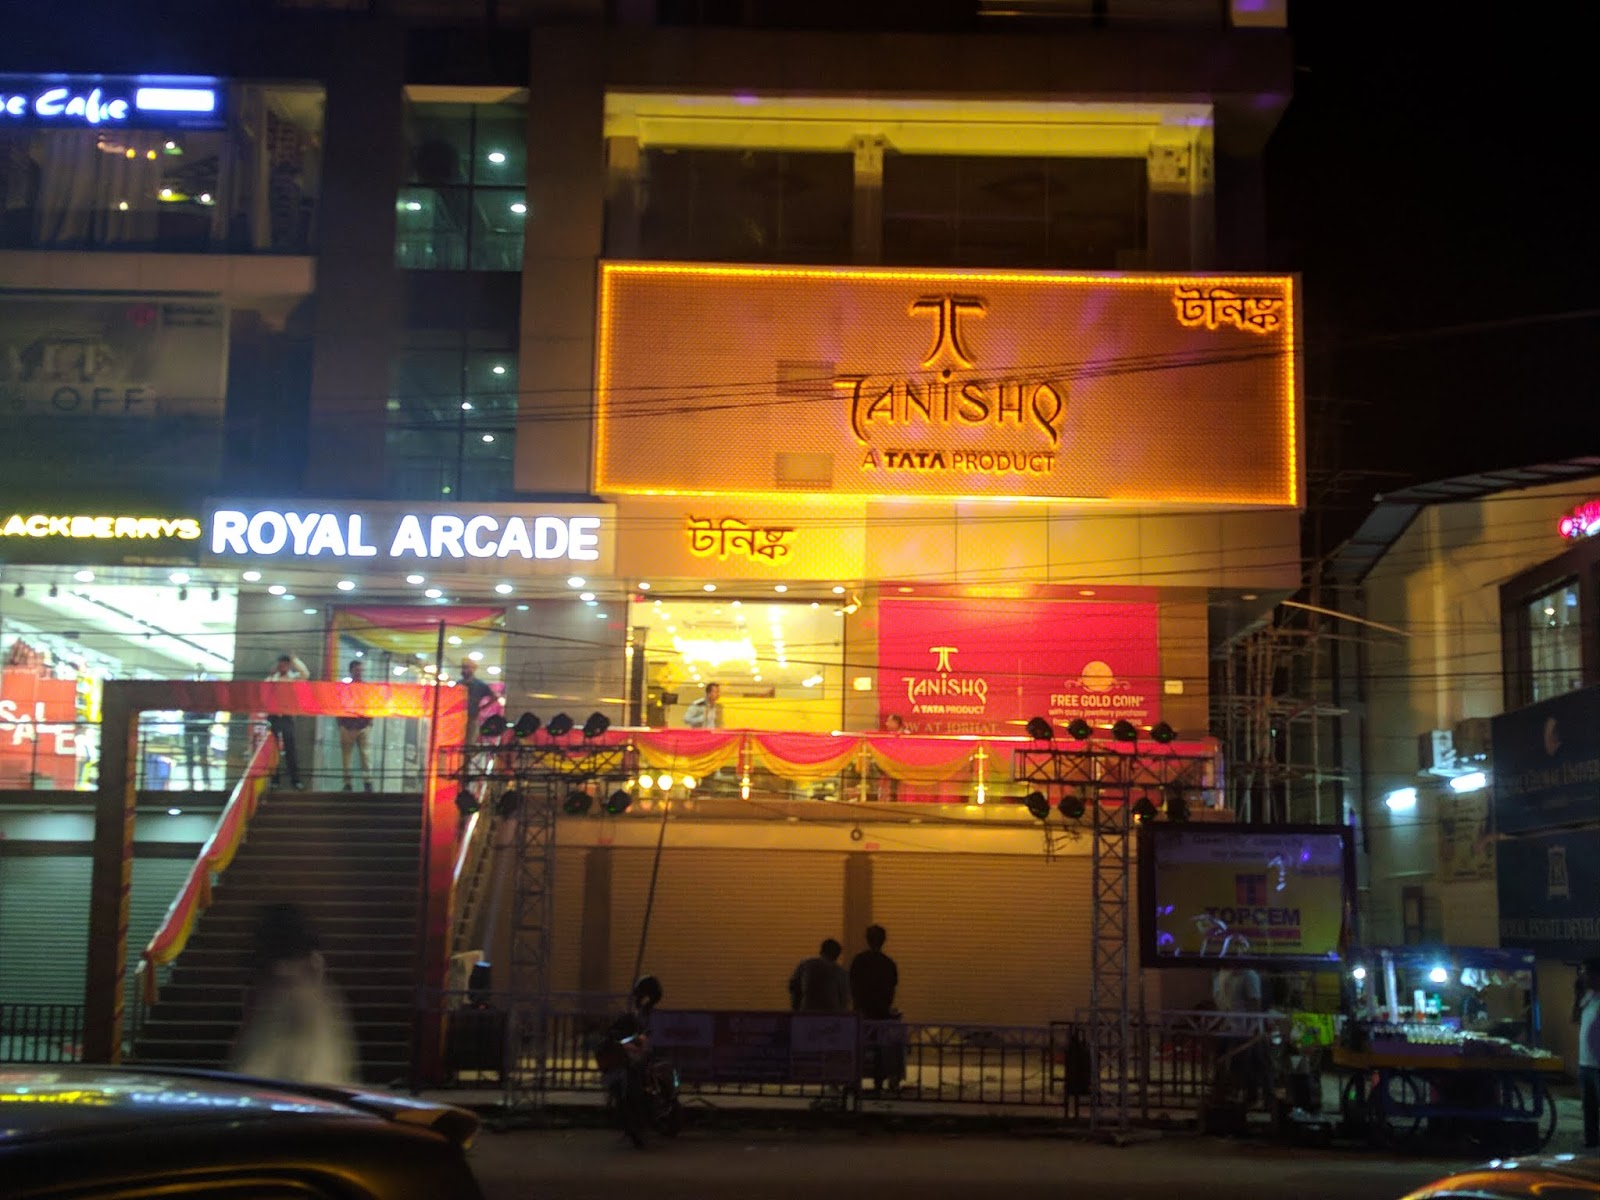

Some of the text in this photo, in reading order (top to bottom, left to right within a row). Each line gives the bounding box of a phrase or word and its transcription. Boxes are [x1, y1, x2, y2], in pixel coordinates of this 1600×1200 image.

[862, 452, 1056, 473] A TATA PRODUCT
[0, 514, 201, 540] ACKBERRYS
[211, 510, 601, 561] ROYAL ARCADE
[921, 704, 945, 714] TATA
[945, 705, 985, 715] PRODUCT
[1050, 694, 1079, 707] FREE
[1080, 694, 1111, 708] GOLD
